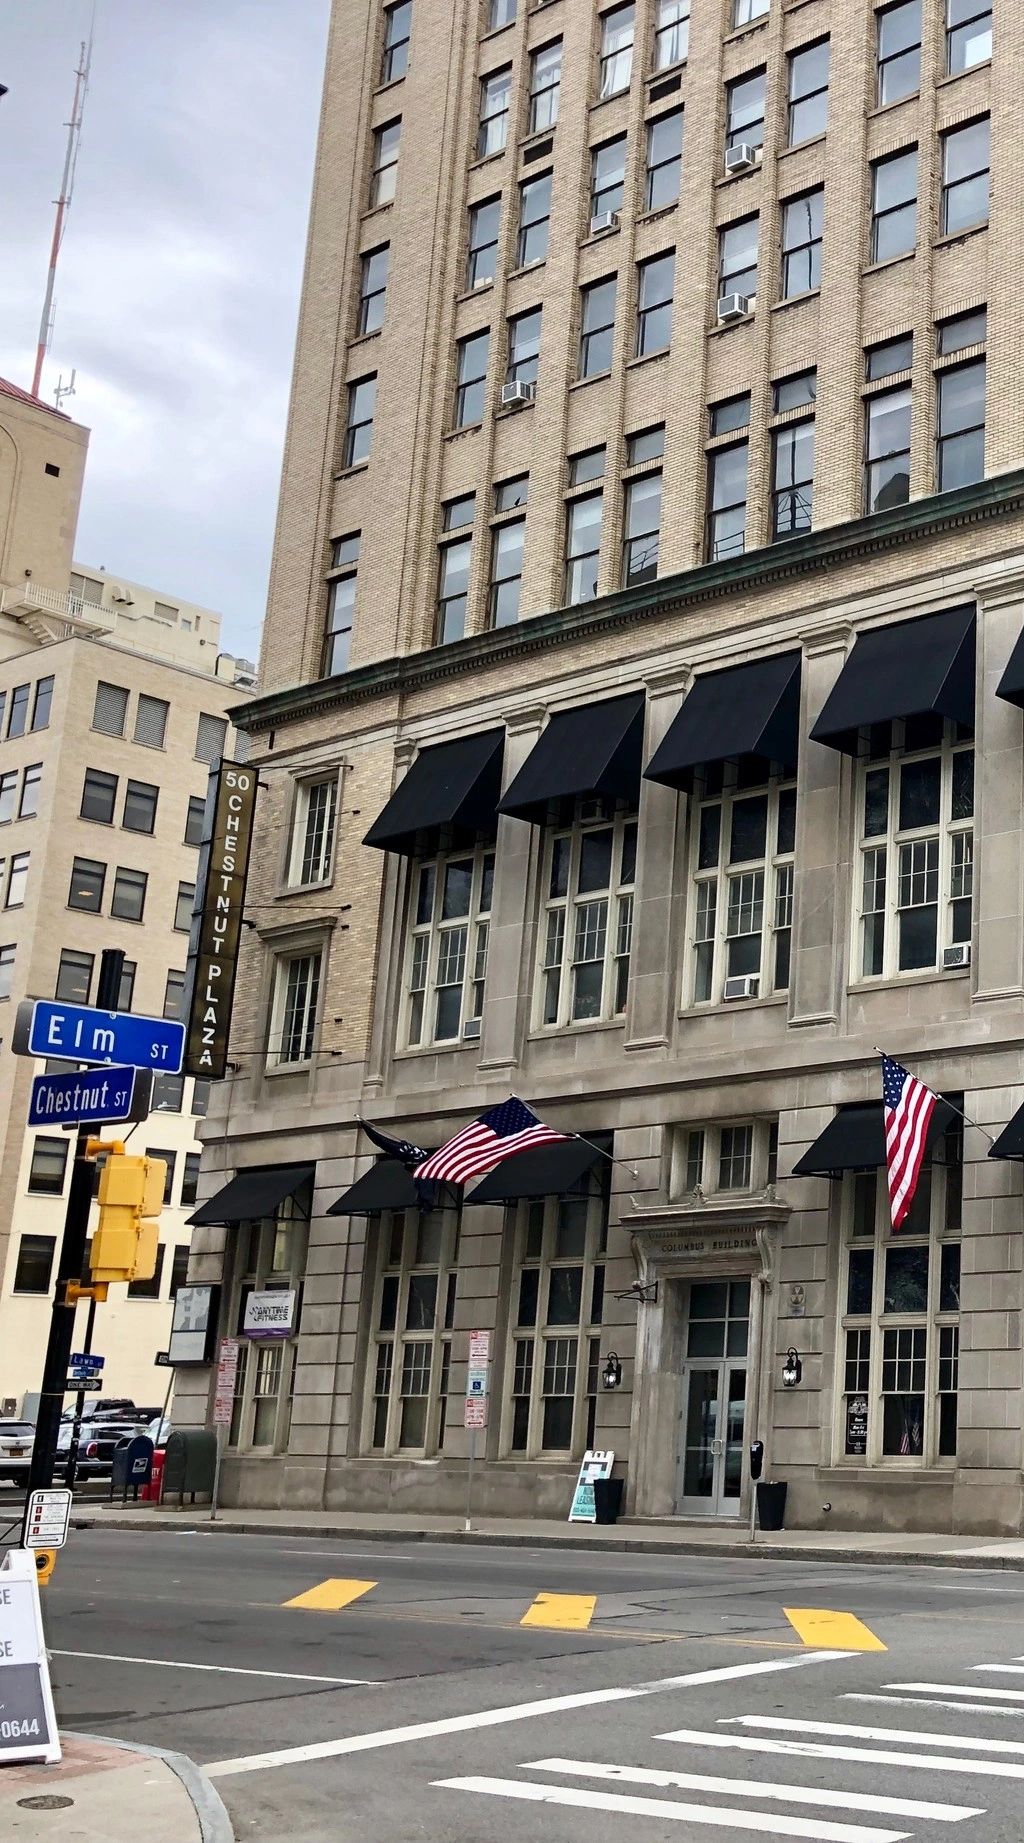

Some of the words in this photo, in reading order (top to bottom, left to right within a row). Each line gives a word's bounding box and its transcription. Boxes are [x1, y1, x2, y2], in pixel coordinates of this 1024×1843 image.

[225, 771, 250, 791] 50
[212, 794, 243, 954] CHESTNUT
[198, 964, 222, 1066] PLAZA
[47, 1014, 115, 1053] Elm
[150, 1043, 169, 1060] ST
[35, 1080, 109, 1115] Chestnut
[115, 1090, 128, 1107] ST
[661, 1242, 705, 1253] COLUMBUS
[712, 1239, 759, 1250] BUILDING
[256, 1313, 288, 1322] FITNESS
[257, 1305, 289, 1315] ANYTIME
[73, 1355, 94, 1365] Lawn
